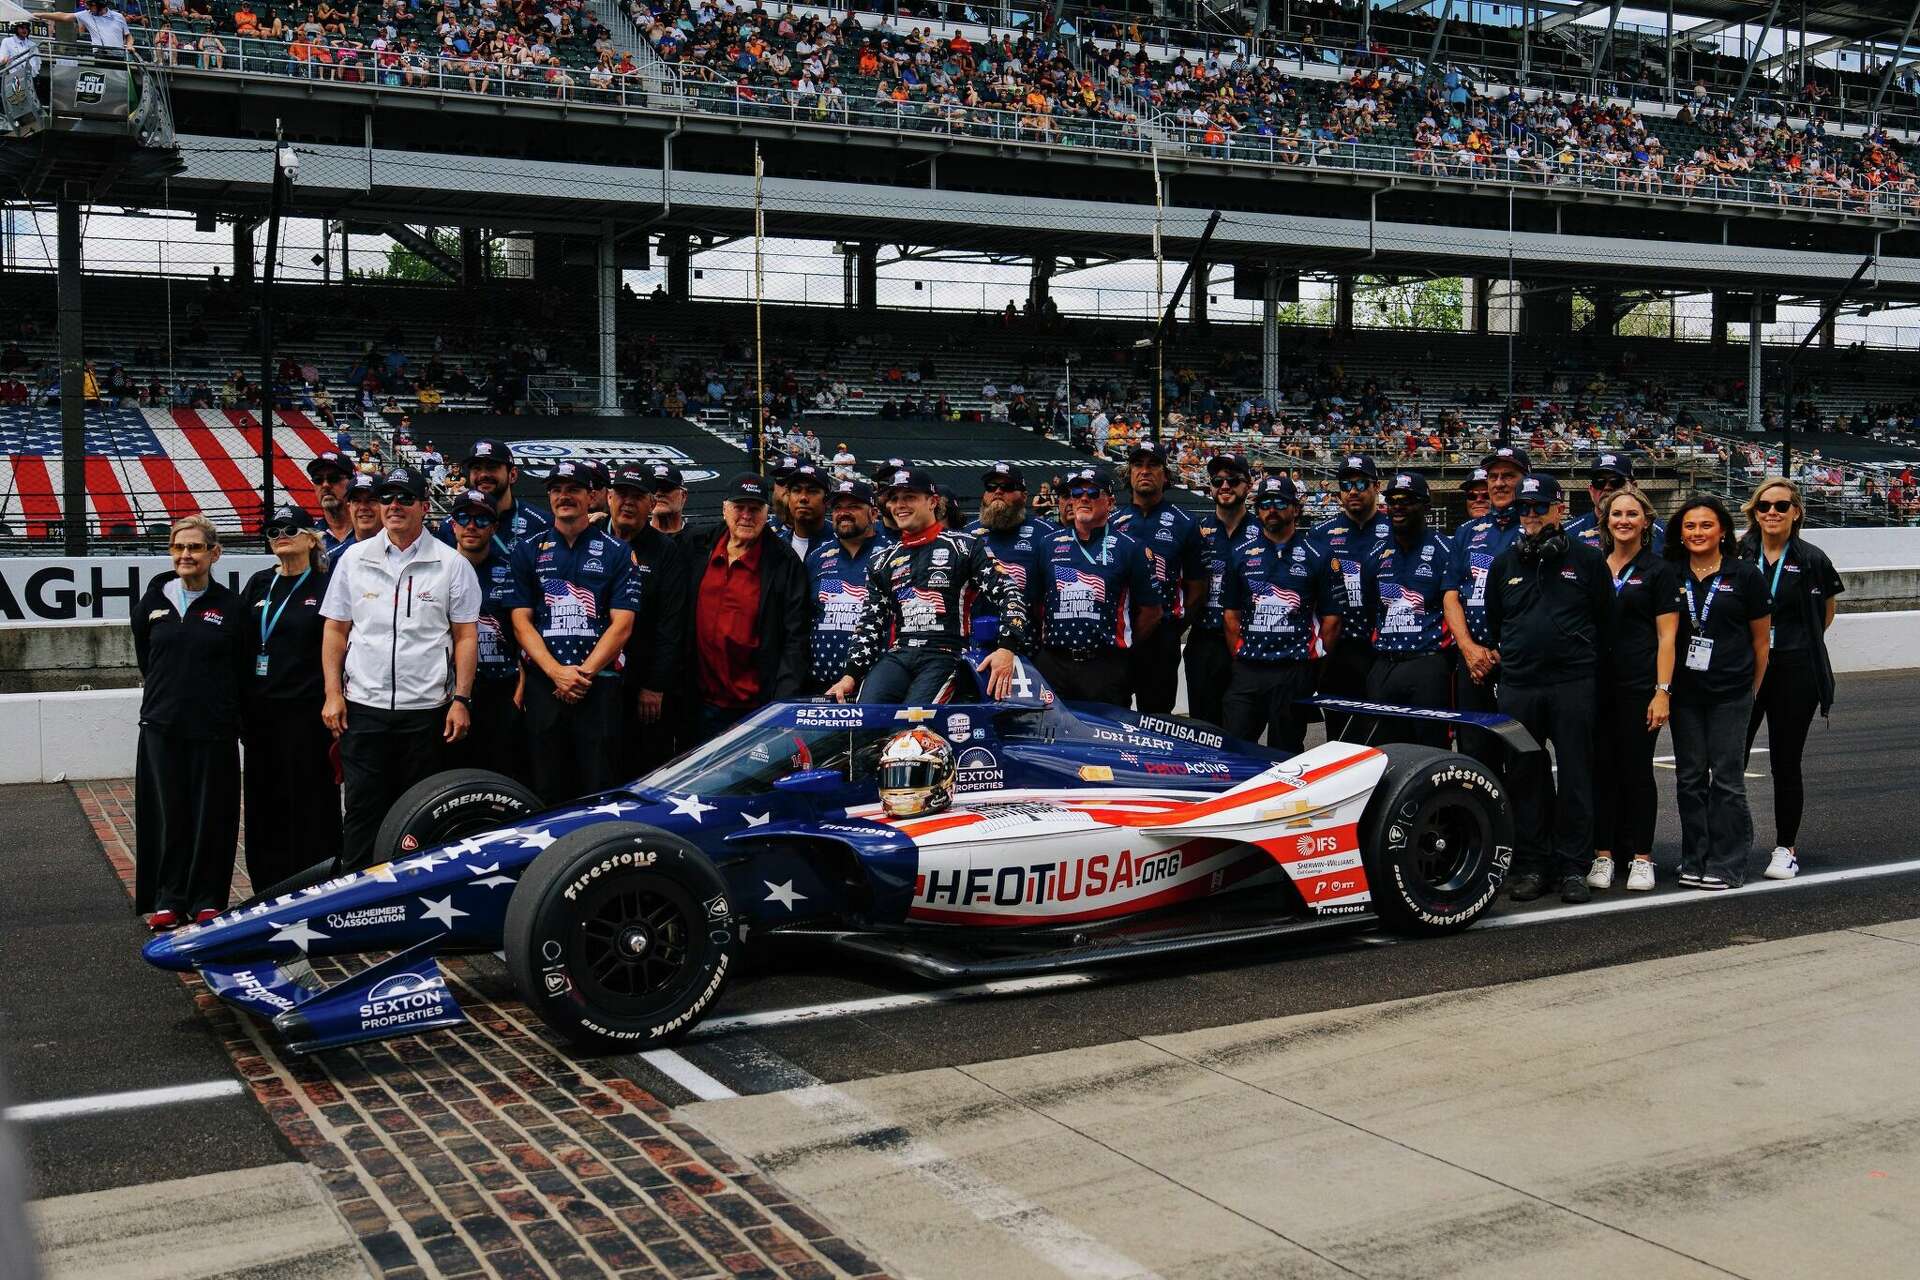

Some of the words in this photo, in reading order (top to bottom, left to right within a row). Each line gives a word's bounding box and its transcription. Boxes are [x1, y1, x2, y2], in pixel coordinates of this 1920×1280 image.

[76, 80, 105, 94] 500
[1060, 590, 1096, 601] HOMES
[823, 603, 863, 612] HOMES
[1068, 600, 1095, 612] TROOPS
[796, 707, 864, 718] SEXTON
[795, 718, 863, 727] PROPERTIES
[1093, 727, 1124, 742] JON
[1126, 734, 1174, 751] HART
[1138, 714, 1223, 749] HFOTUSA.ORG
[1144, 759, 1230, 777] PetroActive
[956, 781, 1004, 793] ROPERTIES
[1432, 766, 1500, 799] Firestone
[432, 792, 524, 820] FIREHAWK
[820, 823, 896, 838] Firestone
[1316, 836, 1337, 852] IFS
[1296, 858, 1355, 870] SHERWIN-WILLIAMS
[564, 849, 658, 901] Firestone
[345, 905, 406, 920] ALZHEIMER'S
[1315, 904, 1365, 915] Firestone
[1420, 883, 1496, 926] FIREHAWK
[343, 912, 406, 928] ASSOCIATION
[649, 952, 729, 1039] FIREHAWK
[359, 990, 442, 1018] SEXTON
[361, 1005, 444, 1030] PROPERTIES
[580, 1018, 608, 1036] 500
[606, 1031, 641, 1040] INDY
